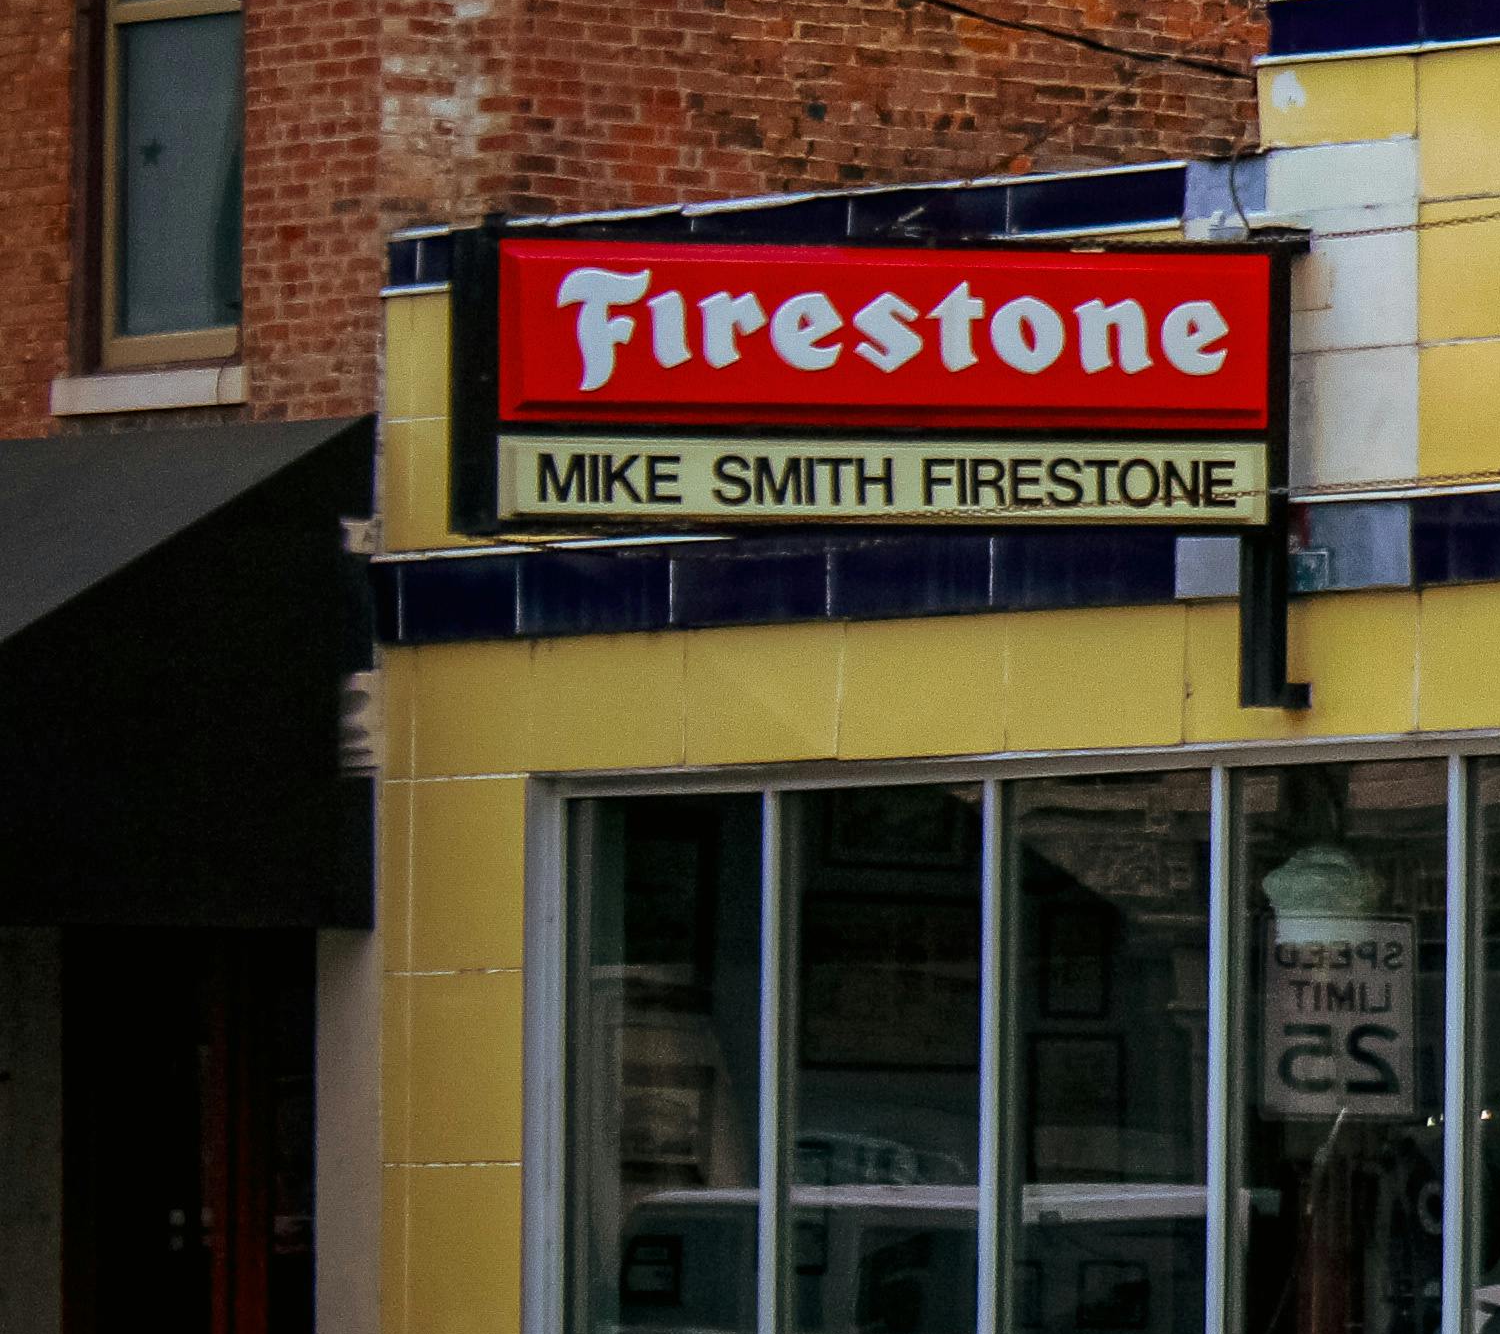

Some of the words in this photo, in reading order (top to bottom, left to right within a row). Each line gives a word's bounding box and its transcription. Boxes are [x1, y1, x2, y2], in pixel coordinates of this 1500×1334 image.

[555, 267, 1230, 393] Firestone
[536, 453, 682, 505] MIKE
[712, 455, 894, 508] SMITH
[920, 457, 1237, 510] FIRESTONE
